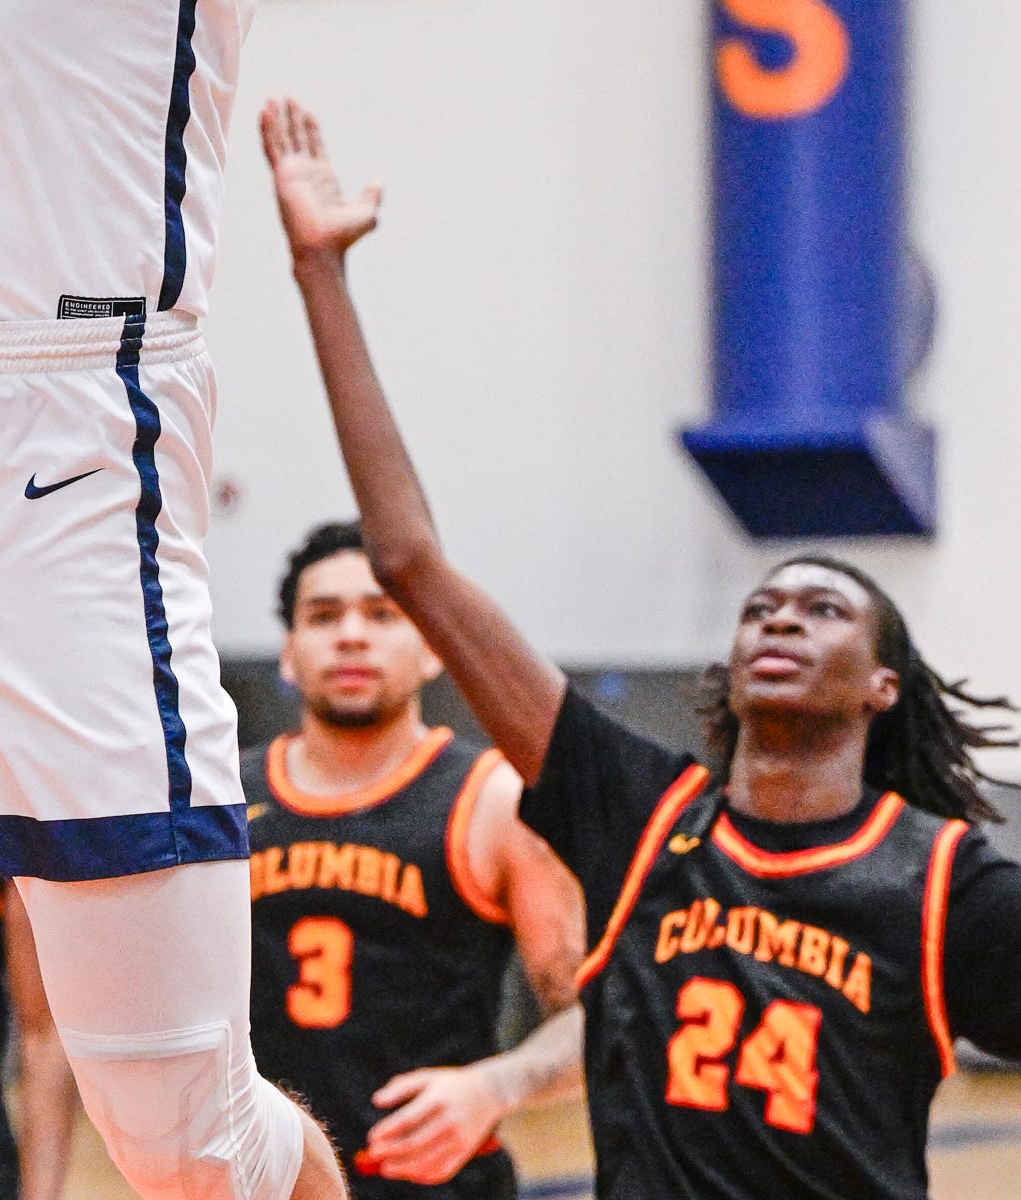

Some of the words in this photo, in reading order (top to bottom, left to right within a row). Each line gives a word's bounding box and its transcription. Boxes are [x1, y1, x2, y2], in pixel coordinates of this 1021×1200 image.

[65, 301, 111, 310] ENGINEERED
[286, 915, 355, 1029] 3
[654, 897, 872, 1014] COLUMBIA
[665, 976, 823, 1134] 24
